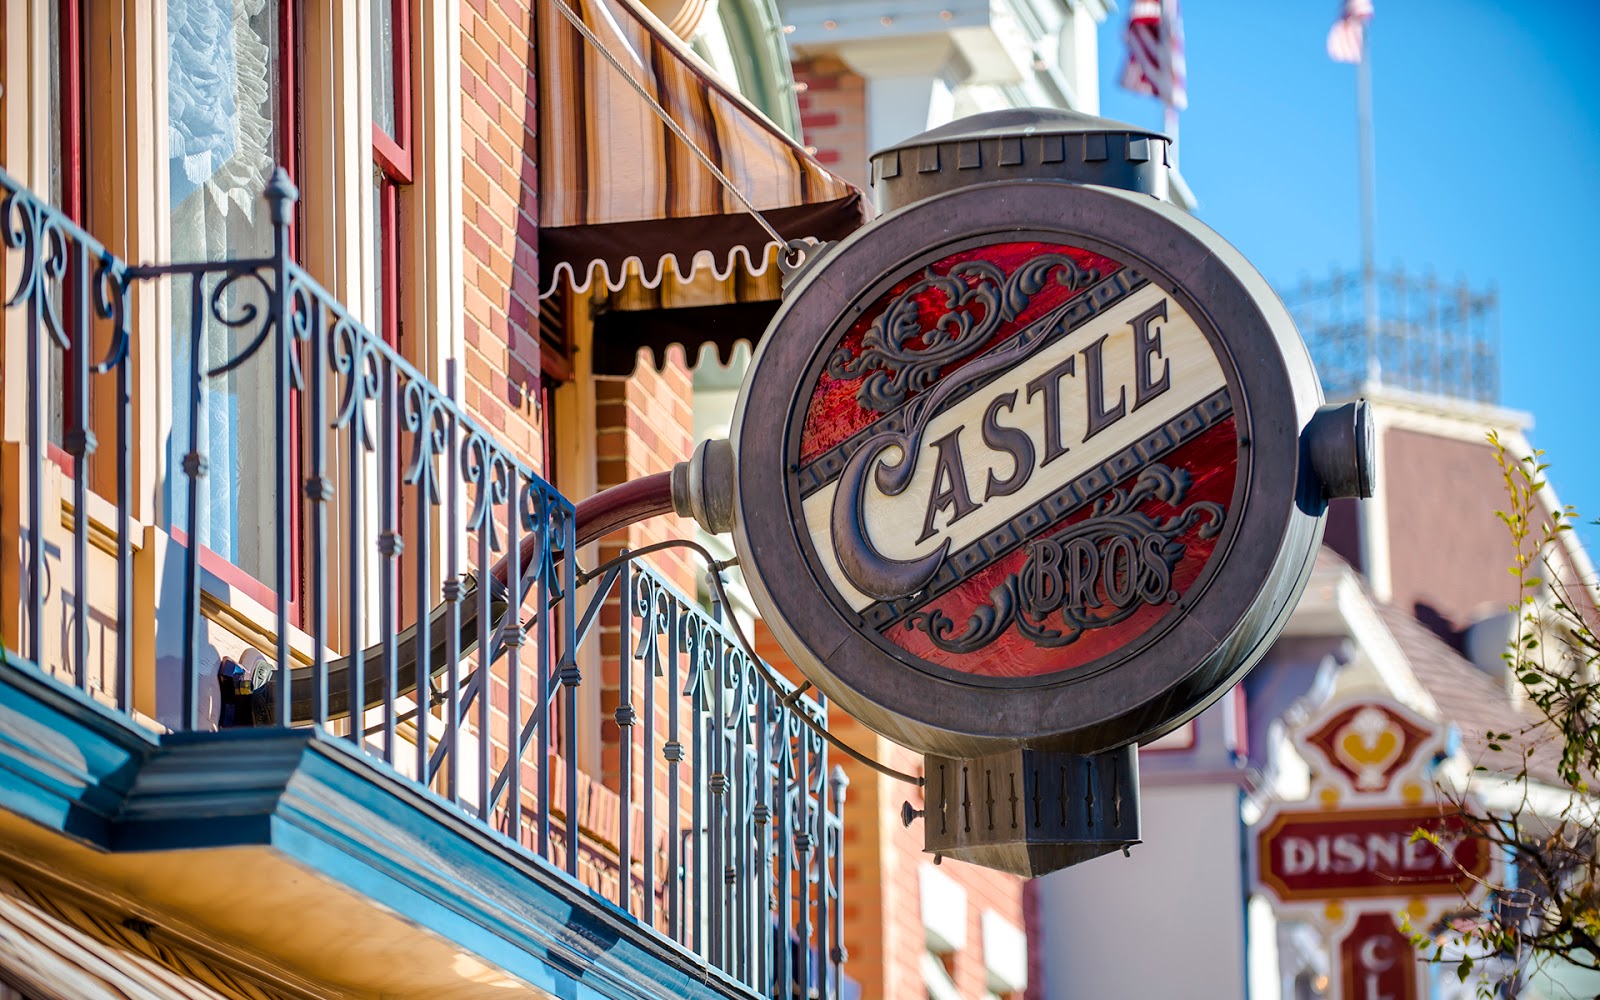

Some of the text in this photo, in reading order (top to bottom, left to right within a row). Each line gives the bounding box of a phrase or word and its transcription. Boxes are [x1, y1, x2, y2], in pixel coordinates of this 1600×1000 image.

[831, 297, 1171, 600] CASTLE
[1030, 533, 1181, 612] BROS.
[1283, 829, 1464, 875] DISNEY
